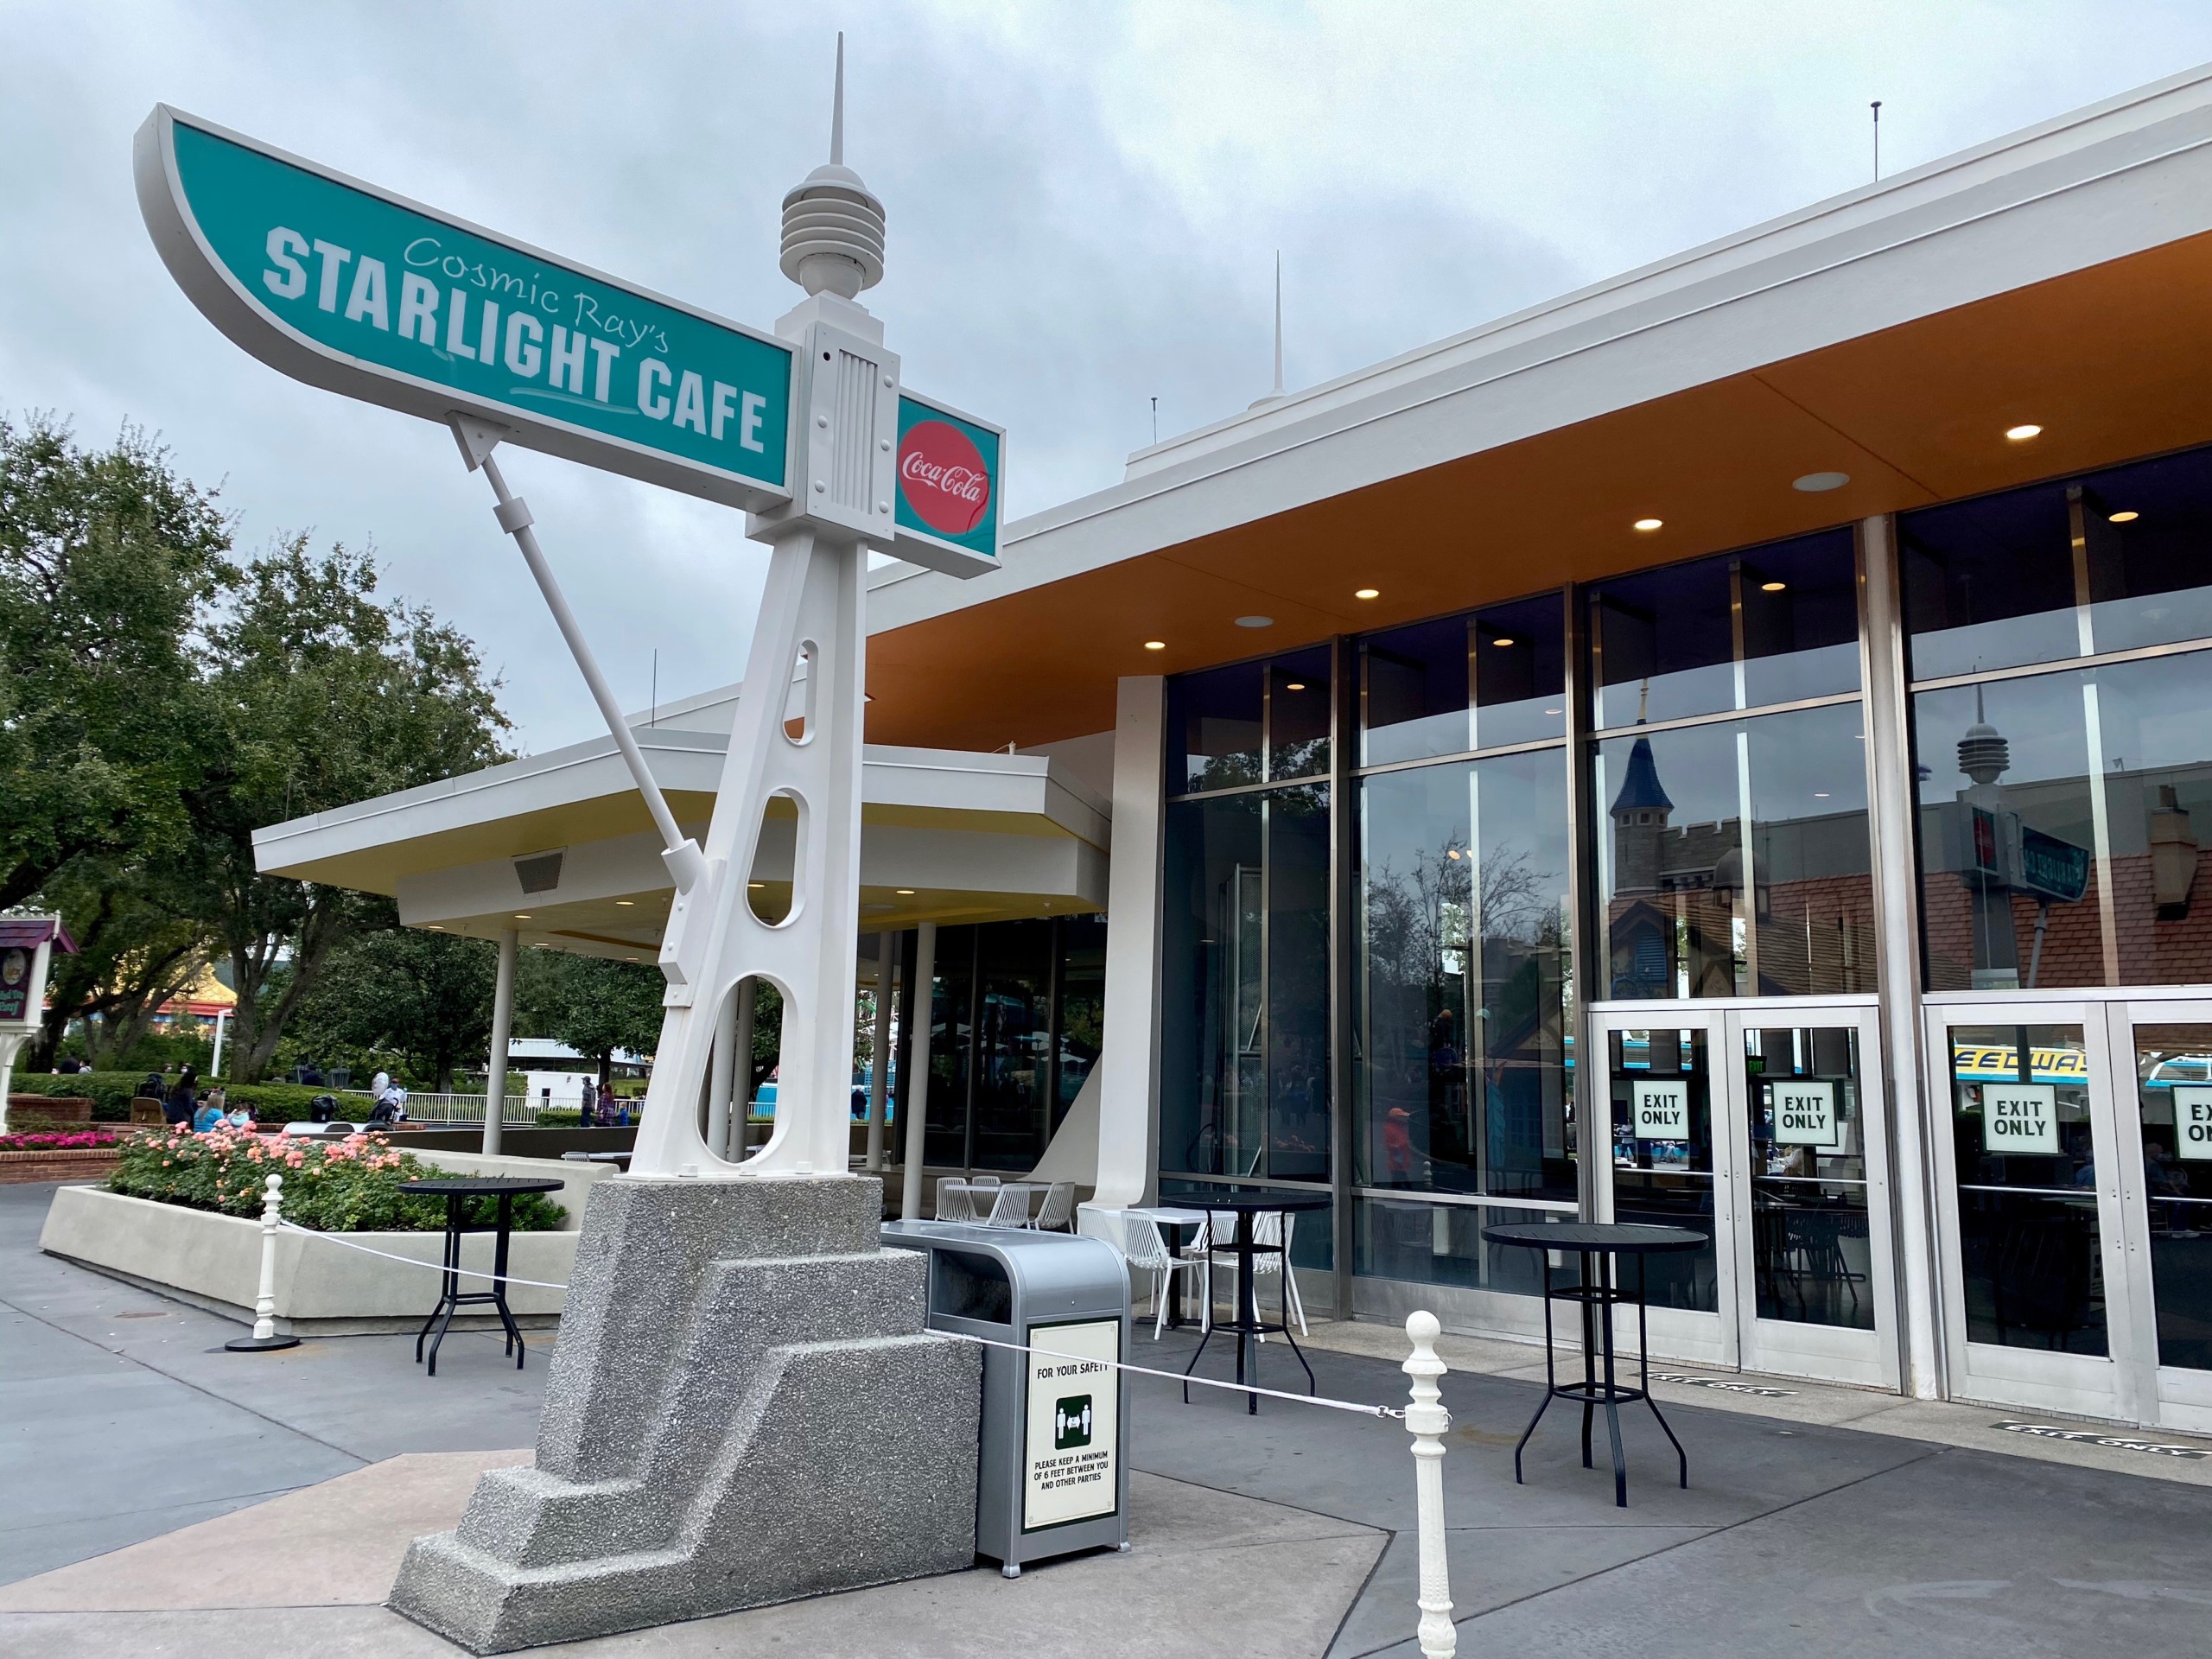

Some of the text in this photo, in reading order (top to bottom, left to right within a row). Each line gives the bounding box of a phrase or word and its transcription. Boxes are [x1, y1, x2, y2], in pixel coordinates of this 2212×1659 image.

[404, 237, 669, 353] Cosmic Ray's
[263, 226, 766, 454] STARLIGHT CAFE
[902, 451, 986, 502] Coca-Cola
[1748, 1060, 1764, 1072] EXIT
[1643, 1094, 1678, 1109] EXIT
[1784, 1096, 1823, 1111] EXIT
[1997, 1100, 2043, 1117] EXIT
[1642, 1110, 1681, 1125] ONLY
[1783, 1114, 1826, 1129] ONLY
[1994, 1119, 2046, 1136] ONLY
[1037, 1367, 1053, 1380] FOR
[1056, 1364, 1077, 1376] YOUR
[1707, 1382, 1777, 1395] ONLY
[2005, 1425, 2190, 1456] EXIT ONLY
[1034, 1459, 1057, 1470] PLEASE
[1058, 1456, 1074, 1467] KEEP
[1081, 1450, 1108, 1462] MINIMUM
[1033, 1472, 1042, 1481] OF
[1044, 1471, 1049, 1479] 6
[1050, 1468, 1065, 1478] FEET
[1066, 1463, 1095, 1476] BETWEEN
[1041, 1472, 1102, 1491] AND OTHER PARTIES
